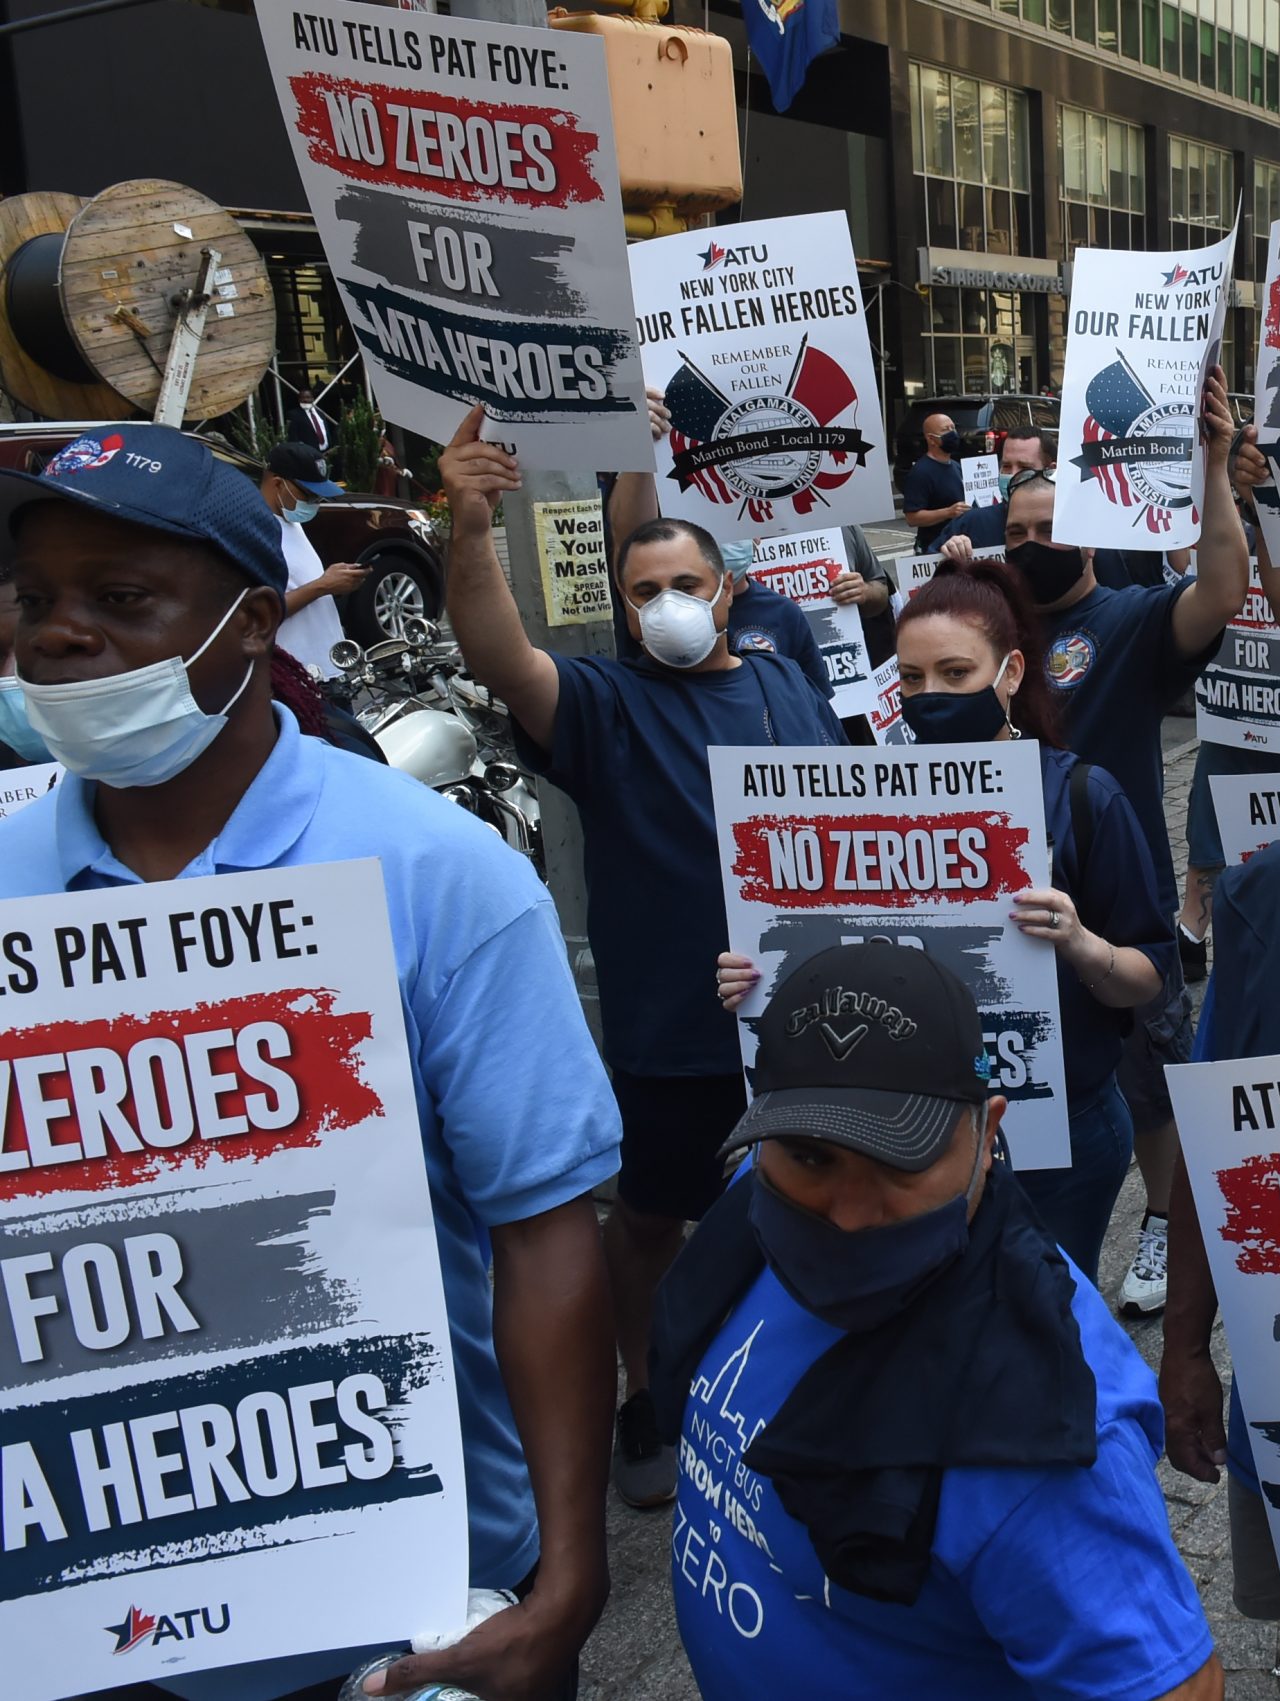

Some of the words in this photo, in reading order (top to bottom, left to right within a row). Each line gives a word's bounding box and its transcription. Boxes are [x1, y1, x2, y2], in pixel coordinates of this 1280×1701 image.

[294, 13, 339, 59] ATU
[344, 21, 421, 71] TELLS
[430, 35, 486, 78] PAT
[488, 42, 570, 91] FOYE:
[325, 92, 386, 167] NO
[388, 103, 557, 193] ZEROES
[407, 219, 500, 297] FOR
[724, 244, 768, 265] ATU
[680, 278, 715, 300] NEW
[718, 272, 759, 294] YORK
[764, 266, 795, 288] CITY
[937, 266, 1018, 290] STARBUCKS
[1019, 273, 1063, 293] COFFEE
[1183, 261, 1222, 287] ATU
[681, 298, 765, 335] FALLEN
[773, 286, 857, 324] HEROES
[1135, 293, 1168, 310] NEW
[1176, 289, 1211, 311] YORK
[1075, 310, 1119, 337] OUR
[1129, 313, 1209, 342] FALLEN
[369, 302, 455, 376] MTA
[455, 331, 608, 401] HEROES
[711, 344, 792, 366] REMEMBER
[730, 374, 782, 391] FALLEN
[741, 362, 768, 374] OUR
[718, 398, 811, 439] AMALGAMATED
[126, 453, 161, 473] 1179
[692, 446, 734, 465] Martin
[737, 437, 769, 453] Bond
[781, 434, 813, 447] Local
[818, 433, 846, 445] 1179
[1101, 443, 1145, 459] Martin
[1150, 443, 1184, 455] Bond
[721, 463, 769, 497] TRANSIT
[793, 450, 820, 489] UNION
[1128, 463, 1172, 507] TRANSIT
[542, 506, 575, 515] Respect
[560, 540, 603, 556] Your
[780, 541, 798, 559] PAT
[800, 537, 830, 555] FOYE:
[555, 559, 606, 578] Mask
[912, 563, 931, 579] ATU
[572, 590, 607, 605] LOVE
[574, 582, 603, 592] SPREAD
[562, 606, 580, 615] Not
[583, 605, 595, 613] the
[1234, 639, 1269, 669] FOR
[1206, 678, 1240, 710] MTA
[1250, 736, 1268, 745] ATU
[743, 764, 785, 797] ATU
[793, 763, 866, 797] TELLS
[875, 763, 919, 796] PAT
[929, 760, 1003, 796] FOYE:
[767, 829, 823, 891] NO
[829, 828, 989, 891] ZEROES
[55, 917, 147, 988] PAT
[168, 899, 318, 973] FOYE:
[785, 986, 918, 1041] Callaway
[2, 1233, 200, 1363] FOR
[70, 1374, 395, 1532] HEROES
[679, 1435, 722, 1500] FROM
[691, 1411, 736, 1468] NYCT
[734, 1461, 763, 1512] BUS
[672, 1502, 763, 1638] ZERO
[152, 1603, 231, 1646] ATU
